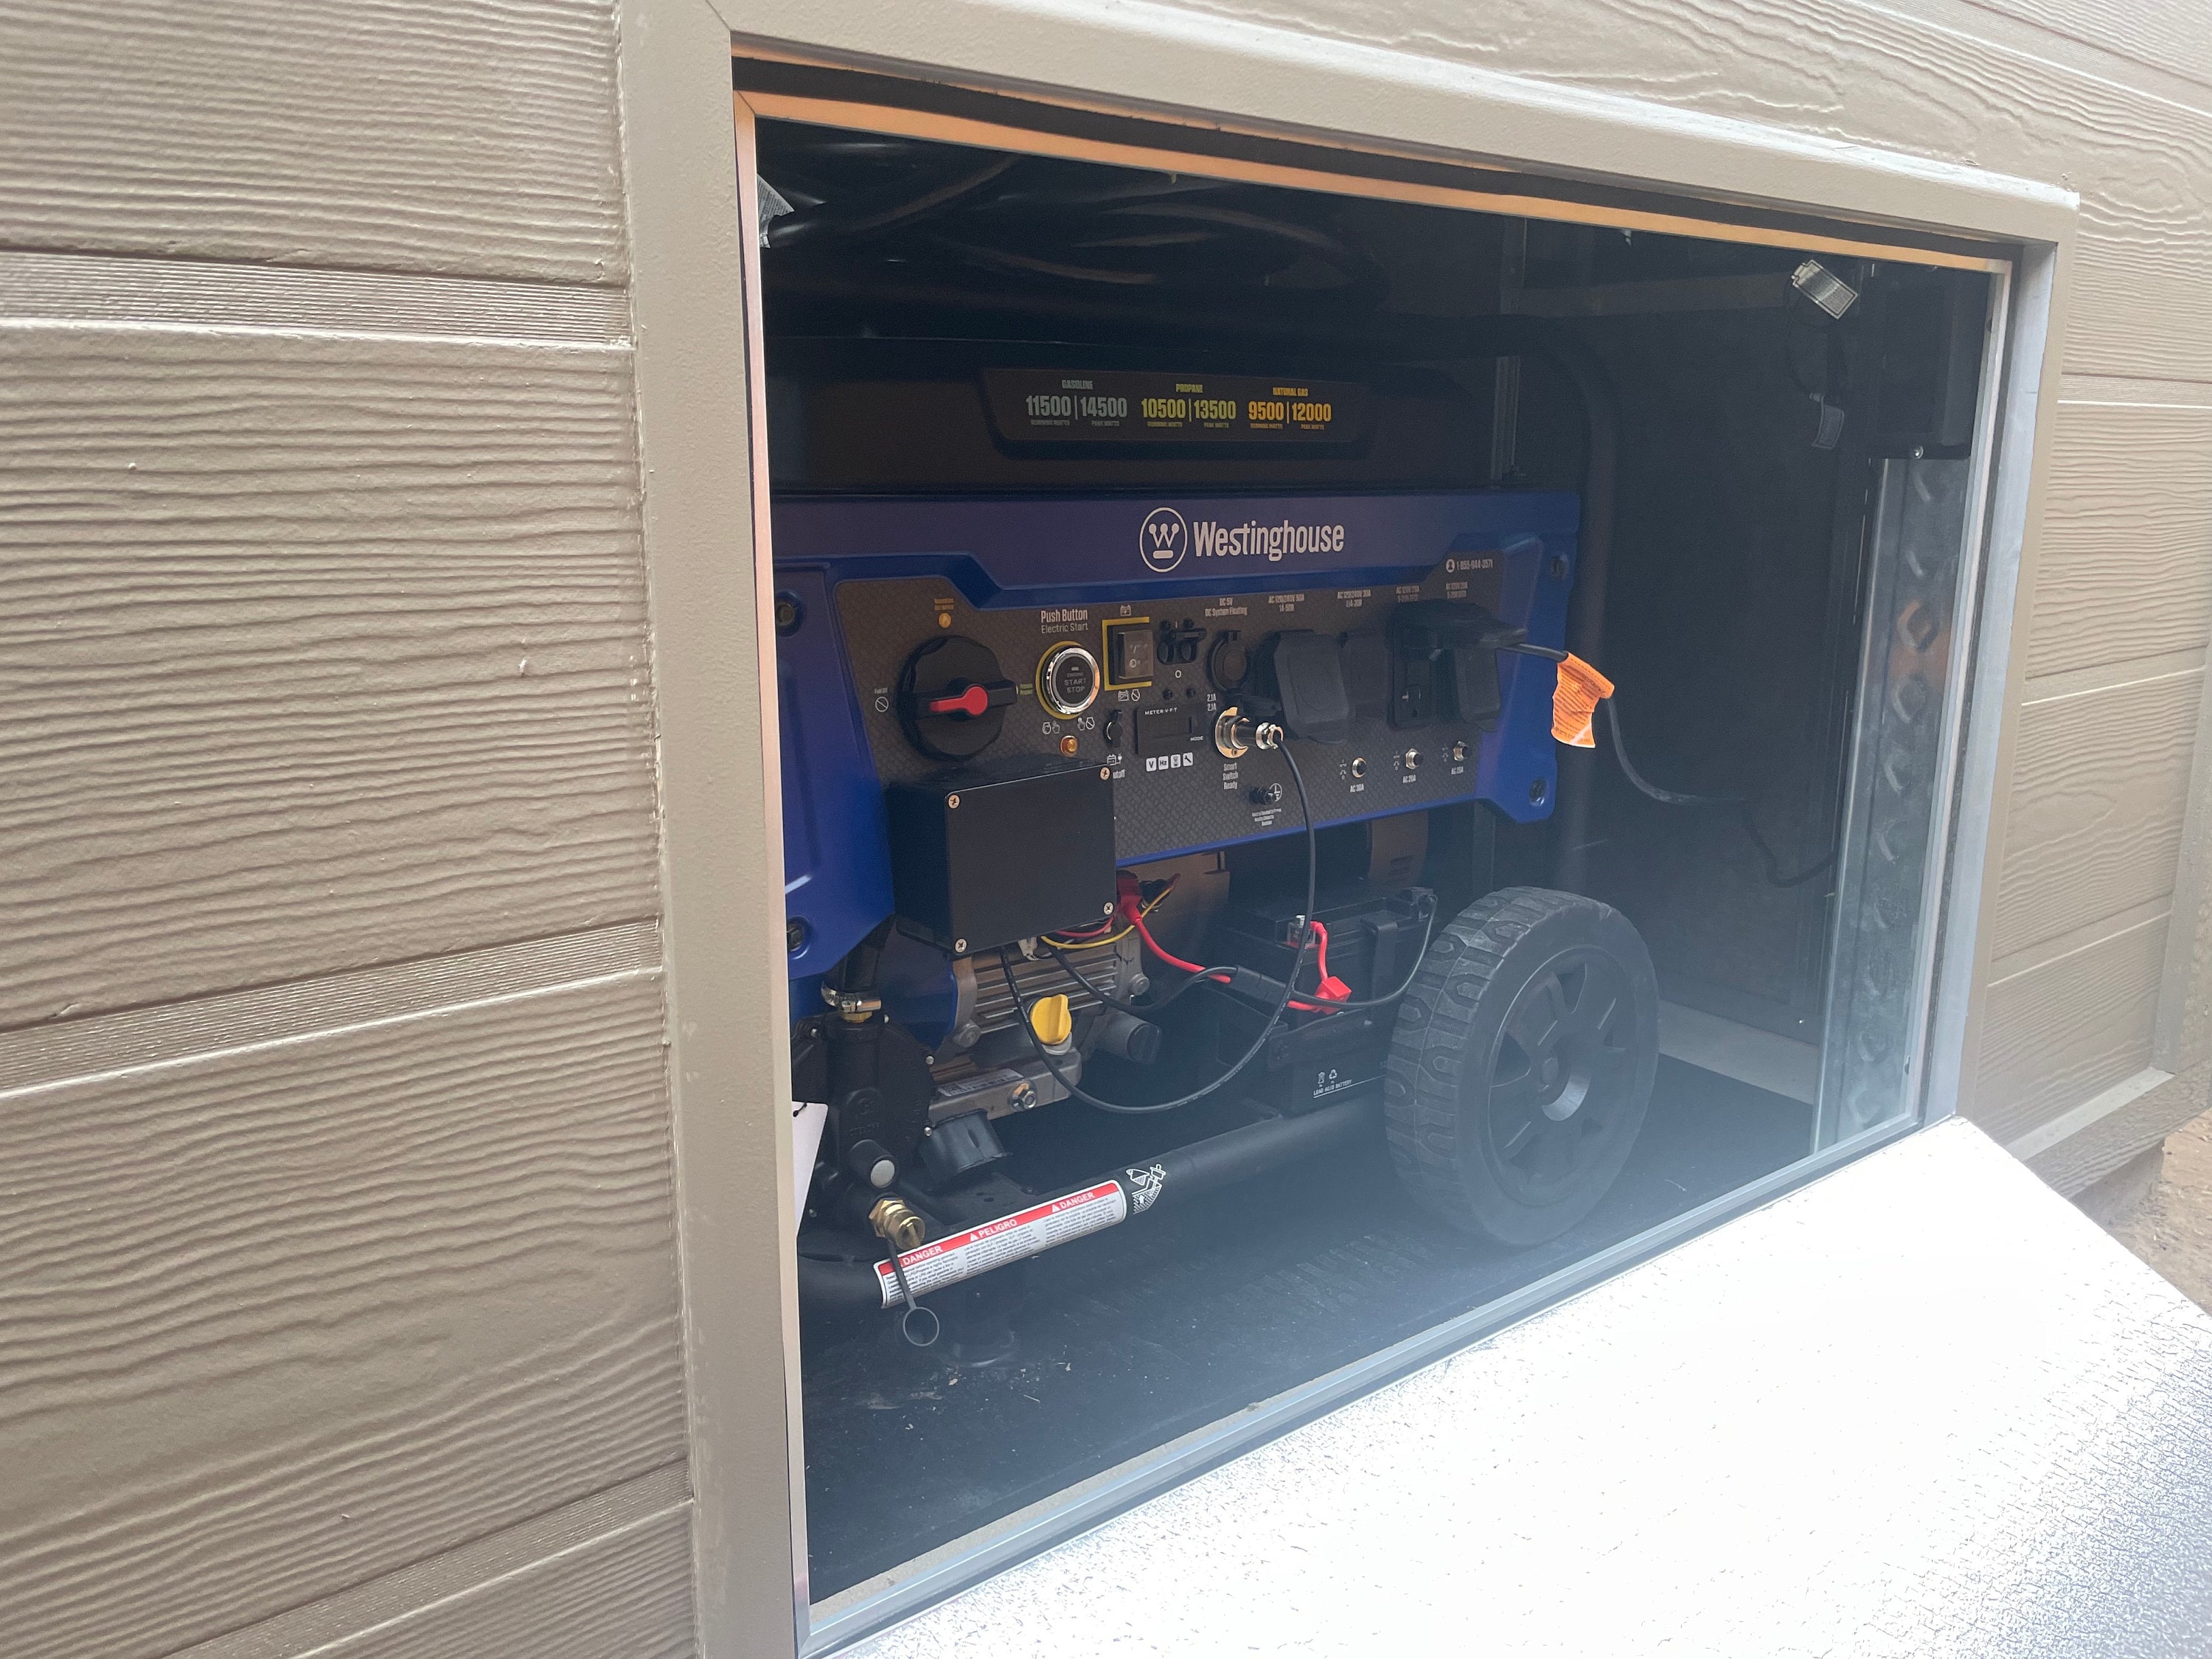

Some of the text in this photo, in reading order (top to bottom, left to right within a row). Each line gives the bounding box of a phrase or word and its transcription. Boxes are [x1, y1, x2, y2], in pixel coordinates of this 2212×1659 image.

[1062, 380, 1093, 390] GASOLINE
[1175, 383, 1203, 393] PROPANE
[1273, 387, 1309, 397] NATURAL GAS
[1026, 395, 1127, 417] 11500 14500
[1141, 398, 1237, 420] 10500 13500
[1248, 401, 1332, 422] 9500 12000
[1193, 520, 1344, 561] Westinghouse
[1040, 608, 1088, 623] Push Button
[1212, 608, 1229, 618] System
[1041, 622, 1088, 634] Electric Start
[1064, 678, 1086, 686] START
[1066, 686, 1085, 694] STOP
[1113, 769, 1125, 779] utoff
[1402, 774, 1416, 784] AC 20A
[1349, 783, 1365, 793] AC 30A
[1335, 1079, 1352, 1089] BATTERY
[1059, 1192, 1095, 1209] DANGER
[978, 1219, 1018, 1238] PELIGRO
[902, 1245, 943, 1265] DANGER
